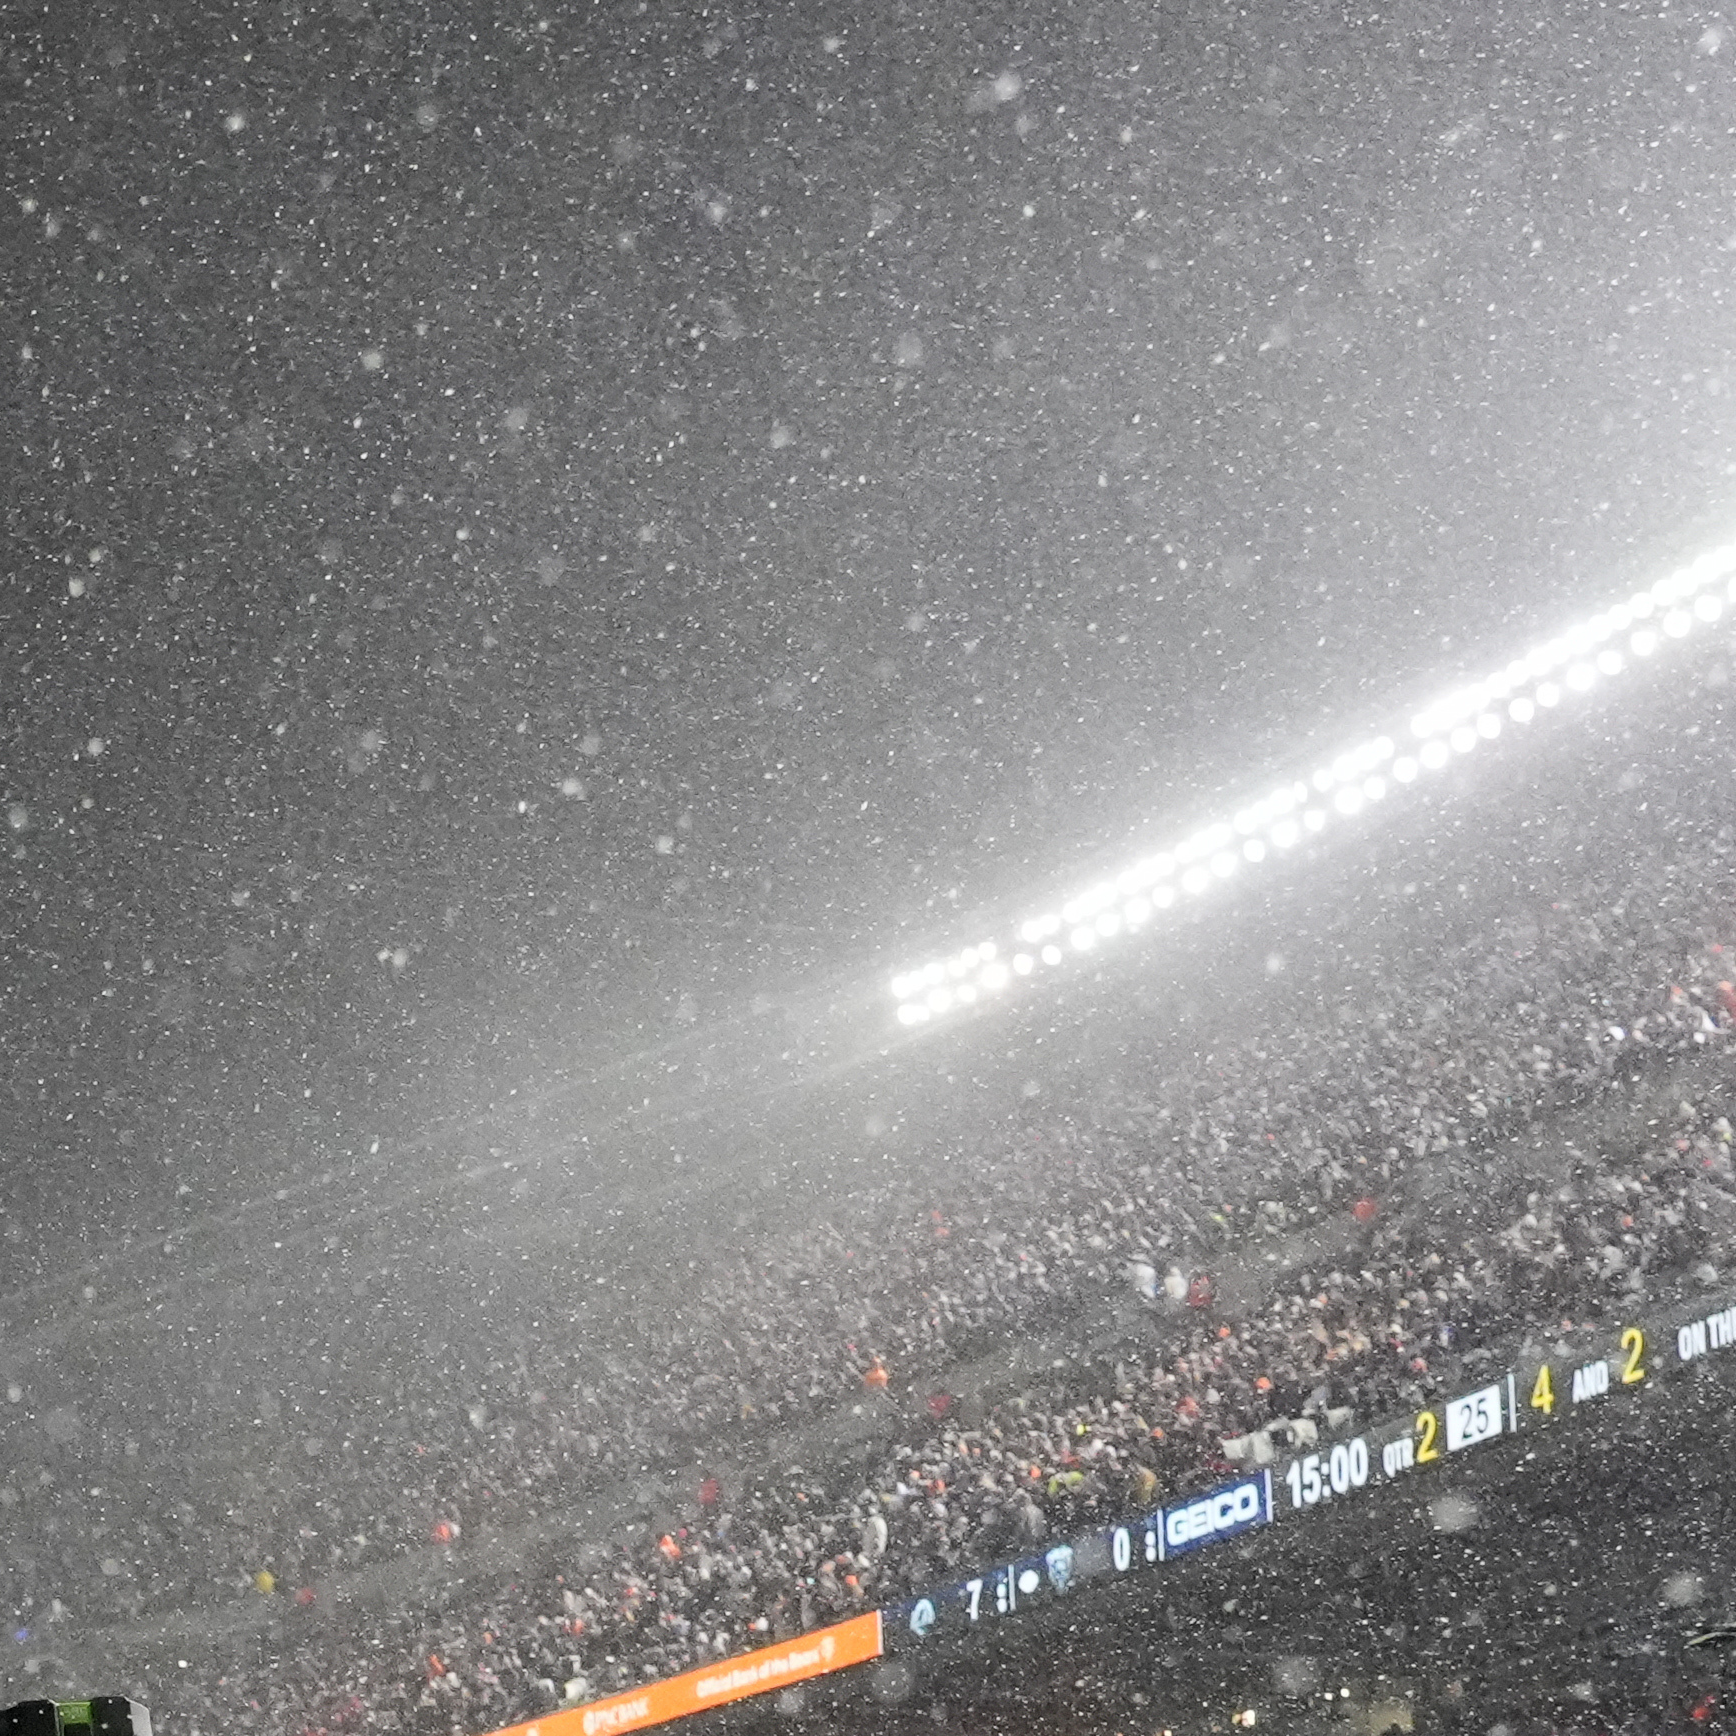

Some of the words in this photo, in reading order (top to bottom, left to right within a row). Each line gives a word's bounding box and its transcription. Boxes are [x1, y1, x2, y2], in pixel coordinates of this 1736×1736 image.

[1531, 1365, 1554, 1414] 4
[1572, 1360, 1609, 1404] AND
[1621, 1327, 1645, 1384] 2
[1678, 1320, 1706, 1361] ON
[1286, 1438, 1368, 1508] 15:00
[1383, 1437, 1414, 1478] QTR
[1416, 1411, 1438, 1463] 2
[1460, 1397, 1489, 1442] 25
[1166, 1483, 1260, 1547] GEICO
[1113, 1527, 1130, 1571] 0
[966, 1578, 983, 1621] 7
